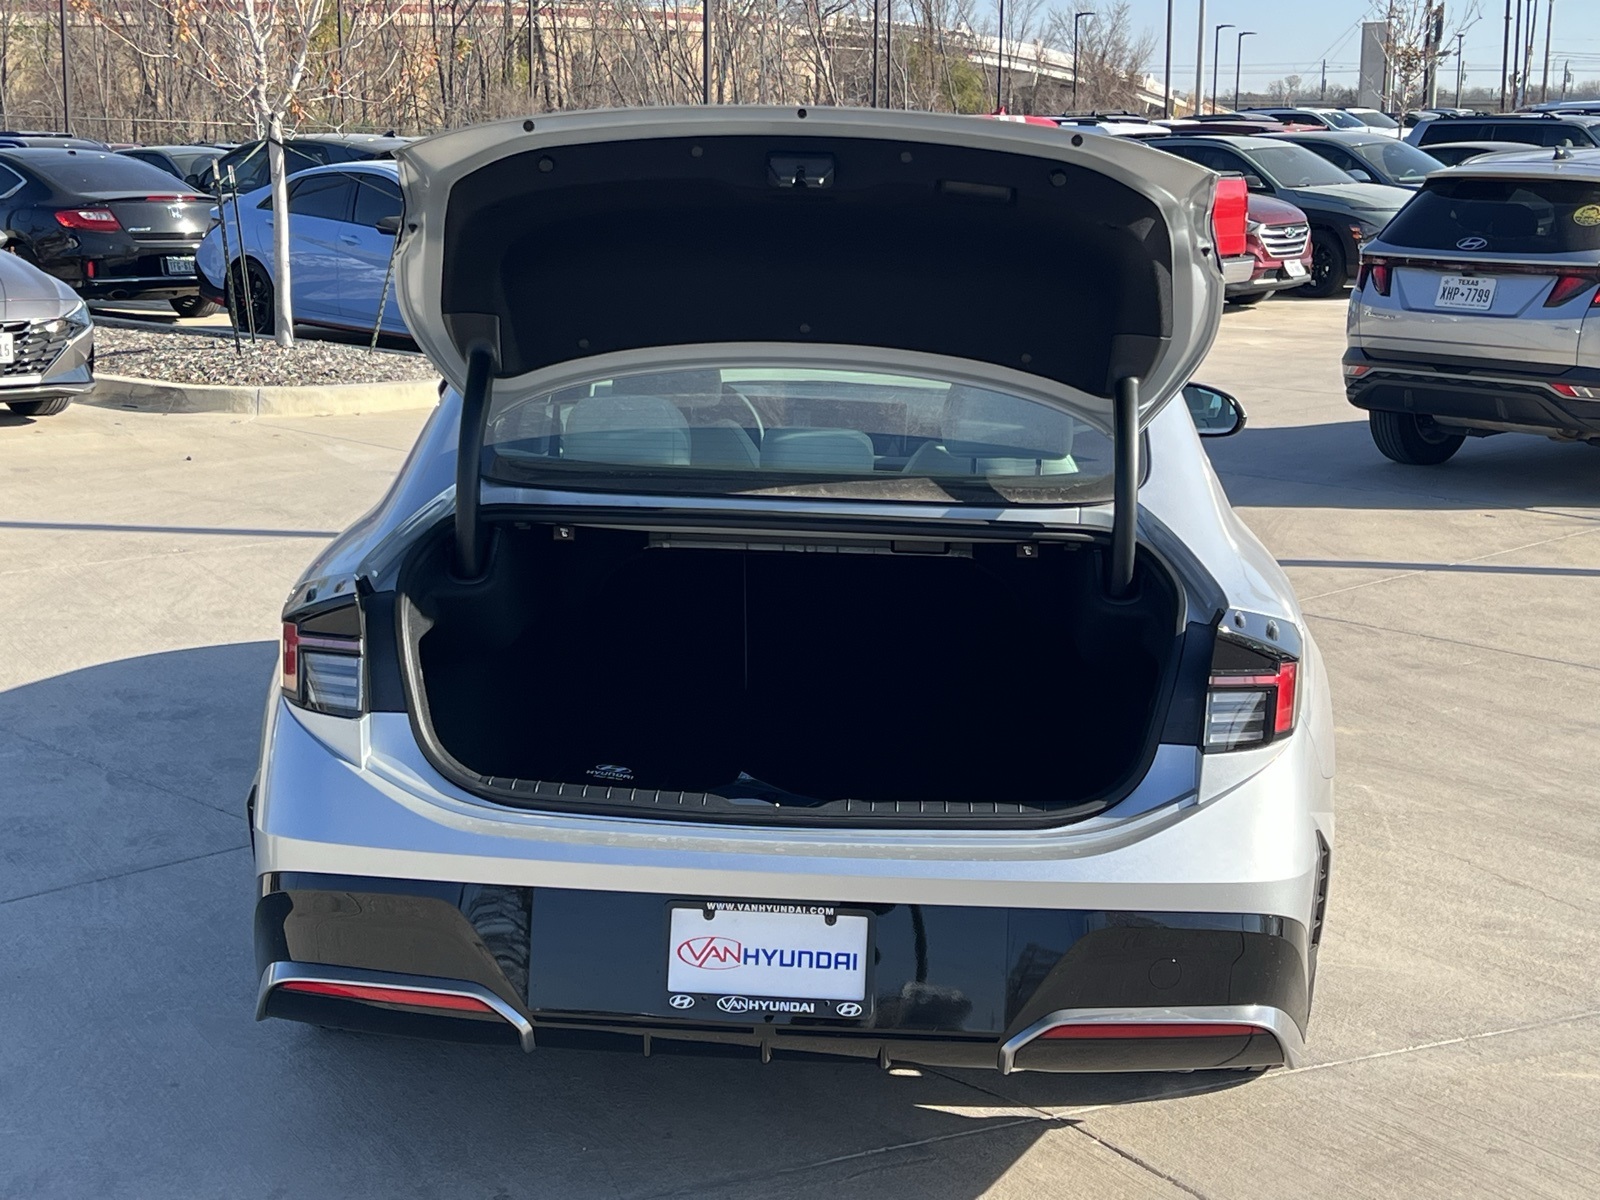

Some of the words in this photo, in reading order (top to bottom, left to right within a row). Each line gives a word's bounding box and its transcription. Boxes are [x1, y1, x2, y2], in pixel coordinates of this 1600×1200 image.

[1458, 278, 1480, 286] TEXAS
[586, 769, 634, 780] HYUNDAI
[706, 902, 835, 916] WWW.VANHYUNDAI.COM
[684, 937, 742, 968] VAN
[743, 947, 858, 971] HYUNDAI
[749, 1000, 815, 1014] HYUNDAI
